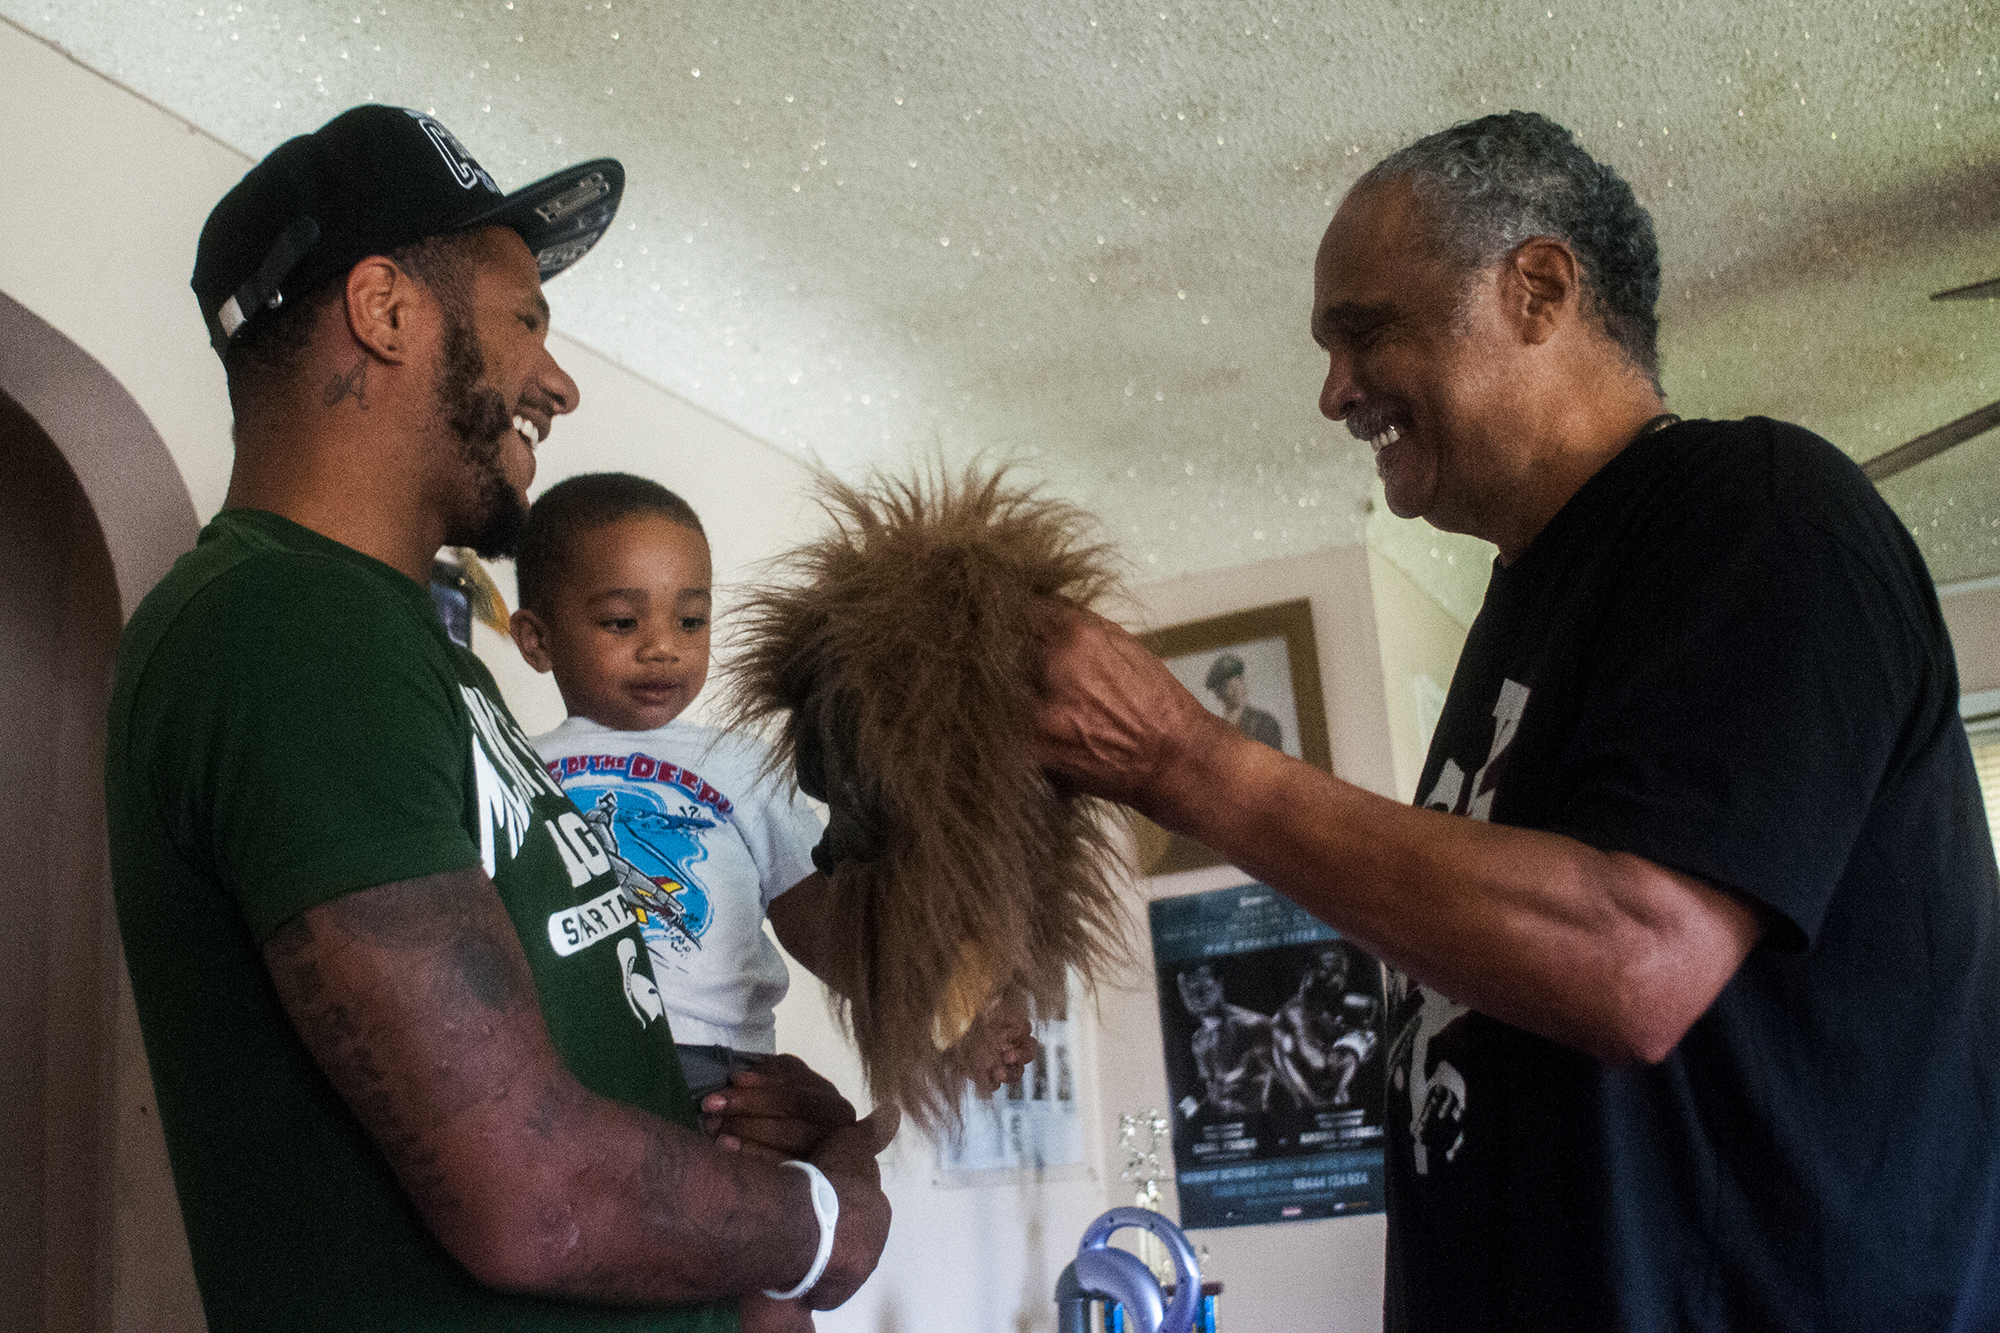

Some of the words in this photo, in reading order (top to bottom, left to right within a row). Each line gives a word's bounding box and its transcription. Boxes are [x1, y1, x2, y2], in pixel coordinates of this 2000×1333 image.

[566, 755, 589, 774] OF
[592, 754, 627, 771] THE
[561, 893, 633, 946] SARTA
